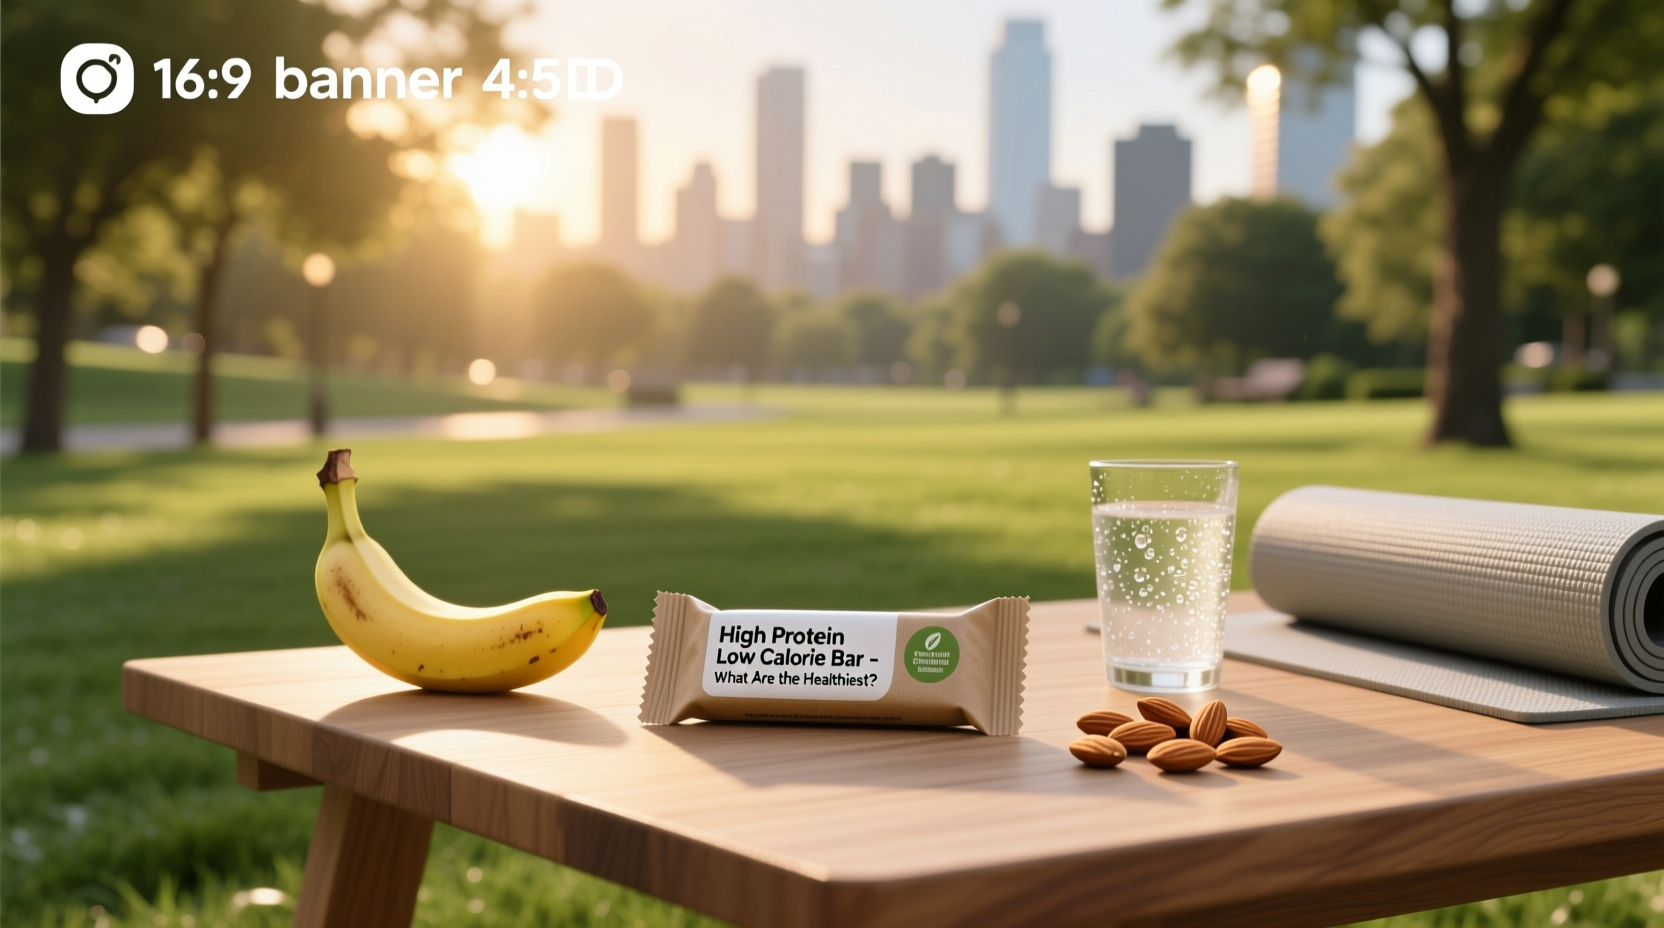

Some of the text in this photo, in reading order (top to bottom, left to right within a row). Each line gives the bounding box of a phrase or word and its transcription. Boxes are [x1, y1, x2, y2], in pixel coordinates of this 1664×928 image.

[719, 625, 845, 649] High Protein
[716, 647, 756, 666] Low
[760, 647, 826, 667] Calorie
[830, 649, 865, 667] Bar
[714, 670, 878, 687] What Are the Healthiest?
